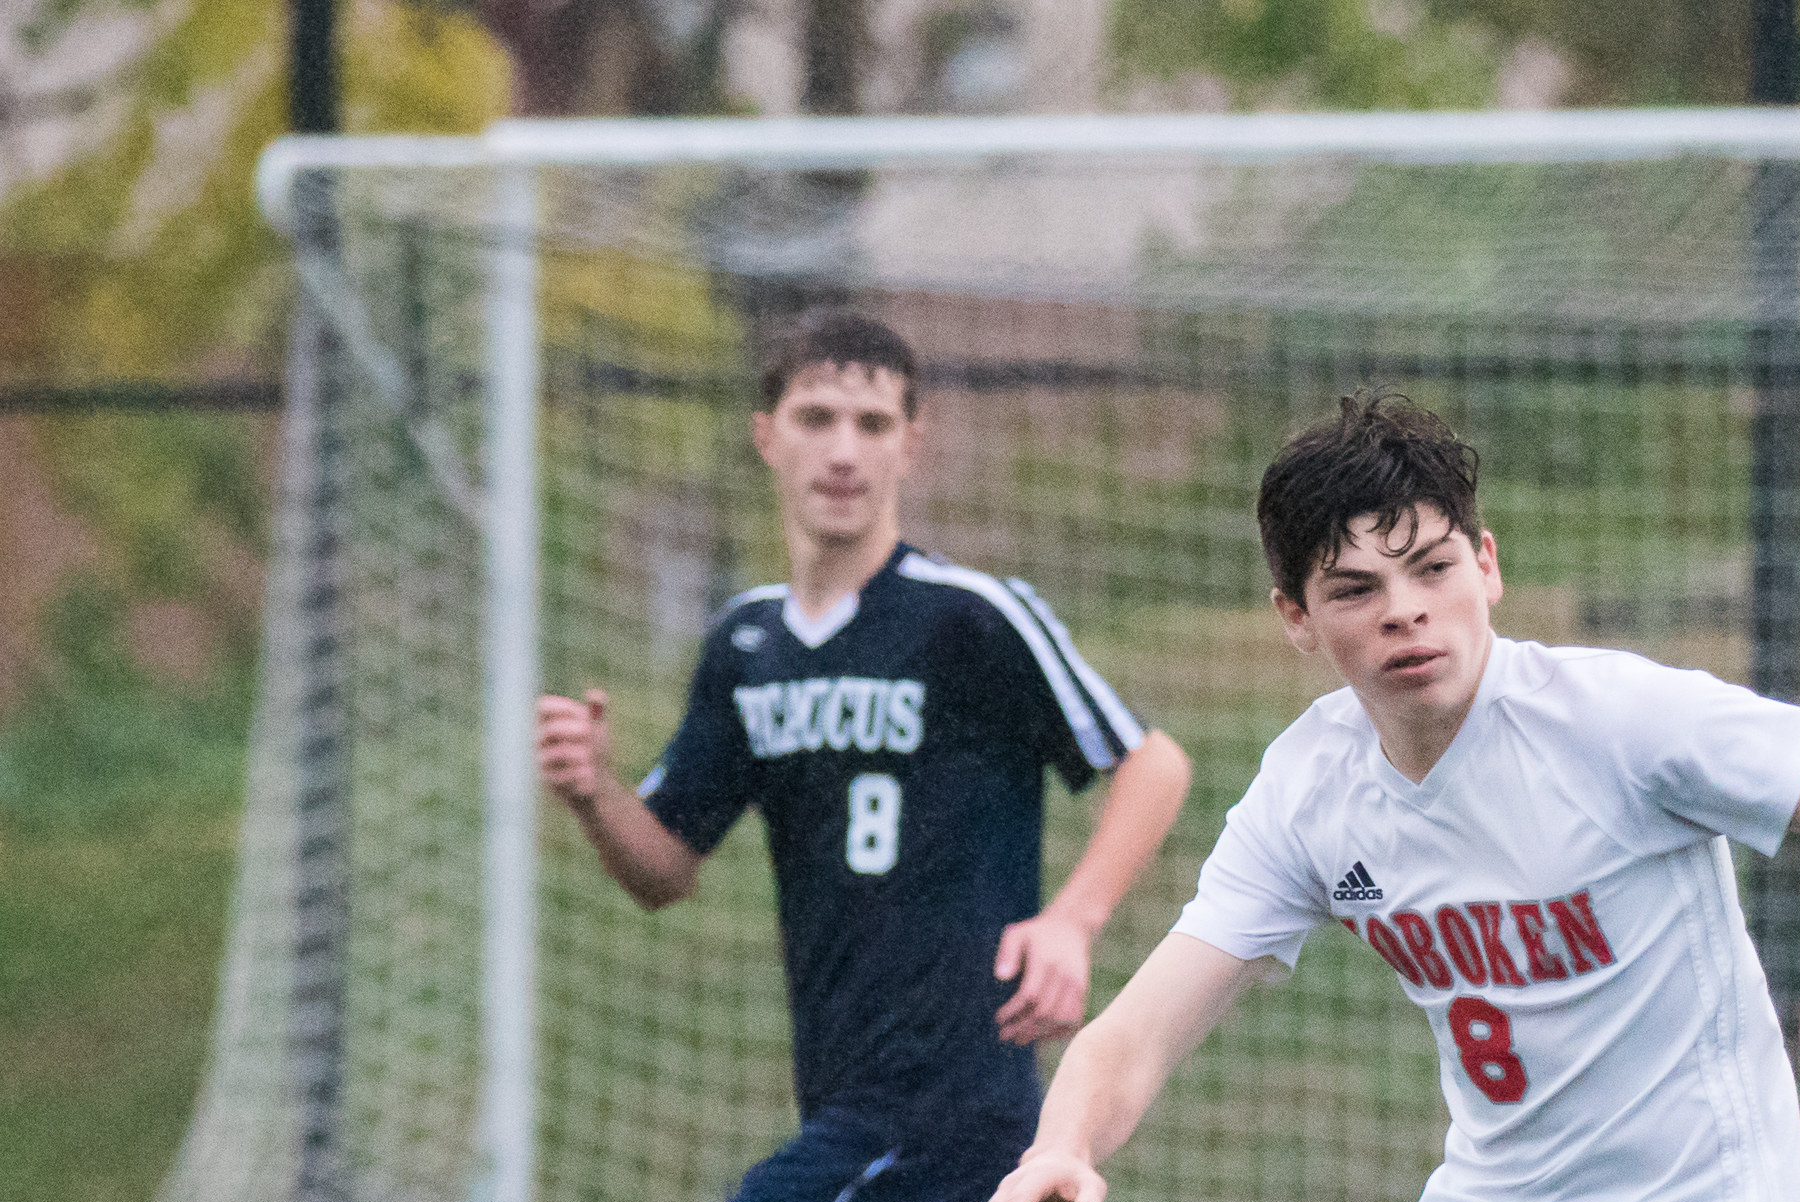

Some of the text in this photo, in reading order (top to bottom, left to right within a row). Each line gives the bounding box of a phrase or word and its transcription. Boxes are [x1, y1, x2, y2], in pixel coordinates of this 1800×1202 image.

[847, 772, 902, 875] 8
[1333, 887, 1384, 901] adidas
[1340, 887, 1618, 990] OBOKEN
[1448, 994, 1528, 1104] 8
